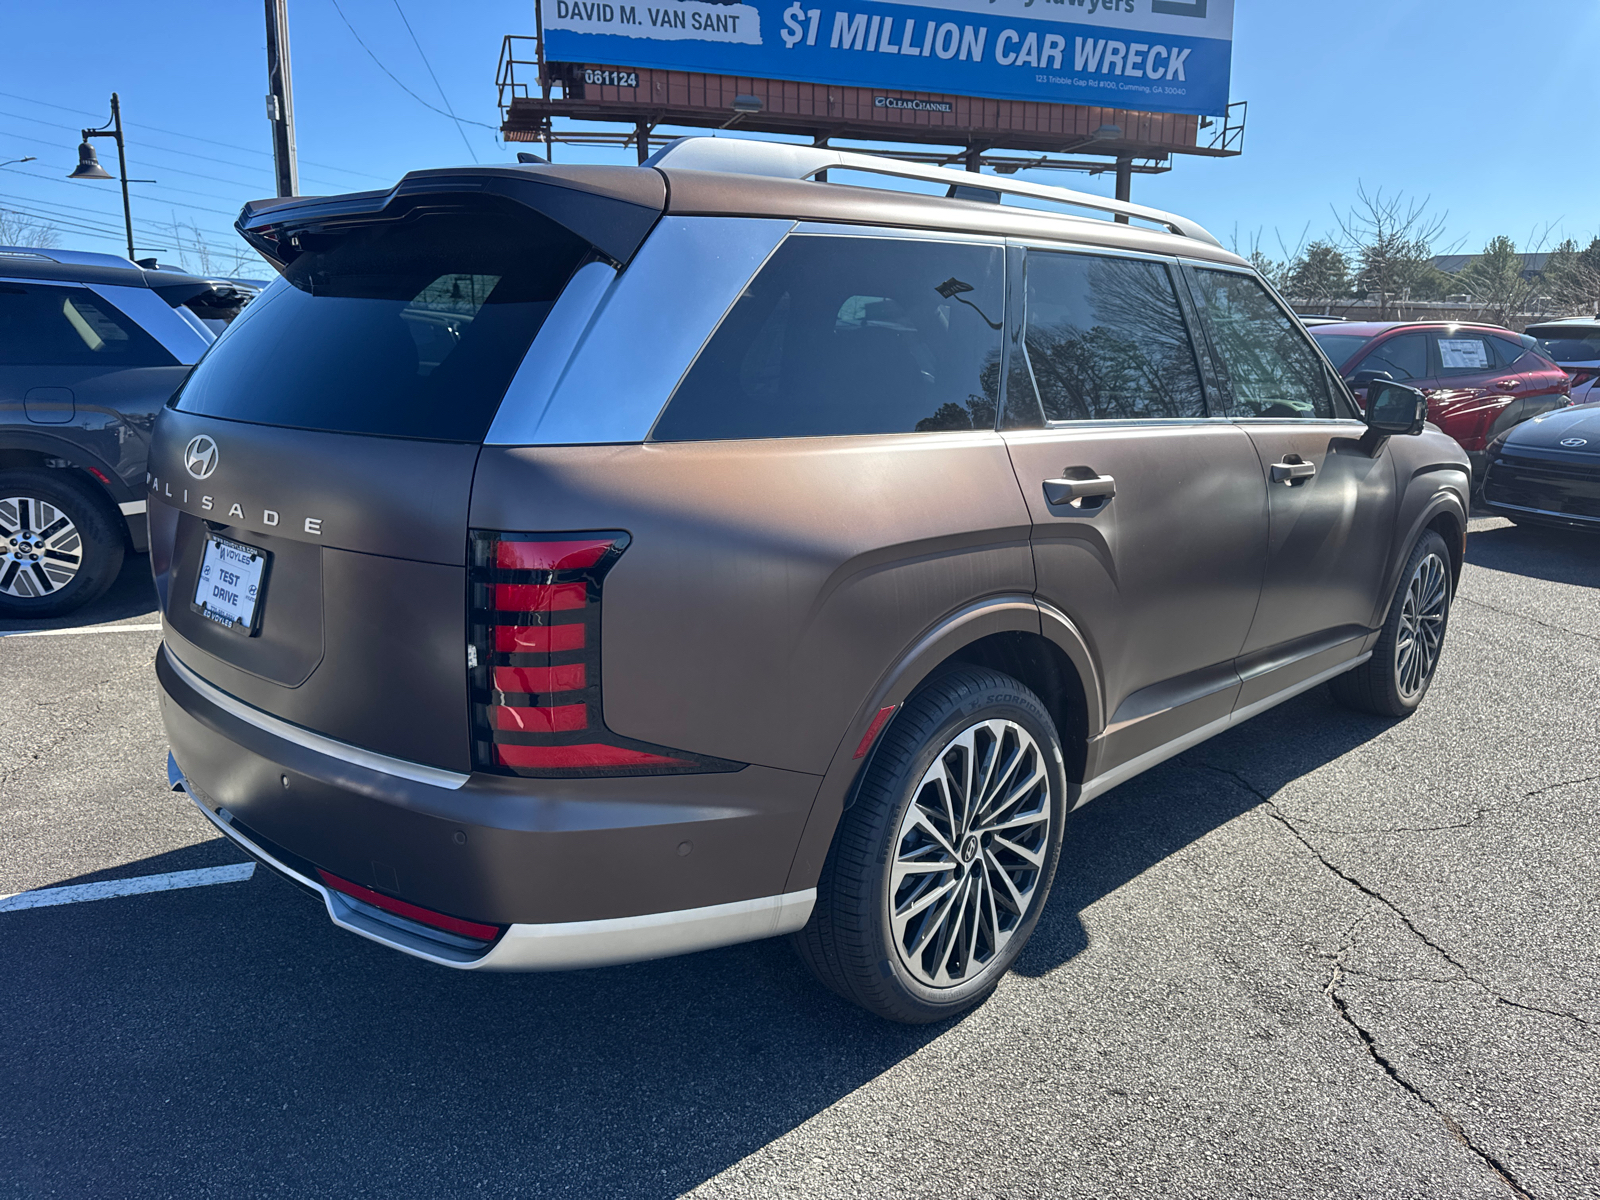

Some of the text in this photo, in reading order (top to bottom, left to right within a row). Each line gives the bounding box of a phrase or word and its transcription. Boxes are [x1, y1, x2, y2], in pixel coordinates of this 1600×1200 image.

[556, 0, 740, 33] DAVID M. VAN SANT
[1045, 0, 1135, 14] yers
[780, 1, 1192, 82] $1 MILLION CAR WRECK
[585, 69, 636, 87] 061124
[1035, 74, 1187, 95] 123 Tribble Gap Rd #100, Cumming, GA 30040
[146, 471, 323, 535] PALISADE
[226, 548, 251, 566] VOYLES
[219, 568, 240, 588] TEST
[212, 585, 239, 607] DRIVE
[211, 613, 233, 628] VOYLES
[986, 694, 1043, 718] SCORPION
